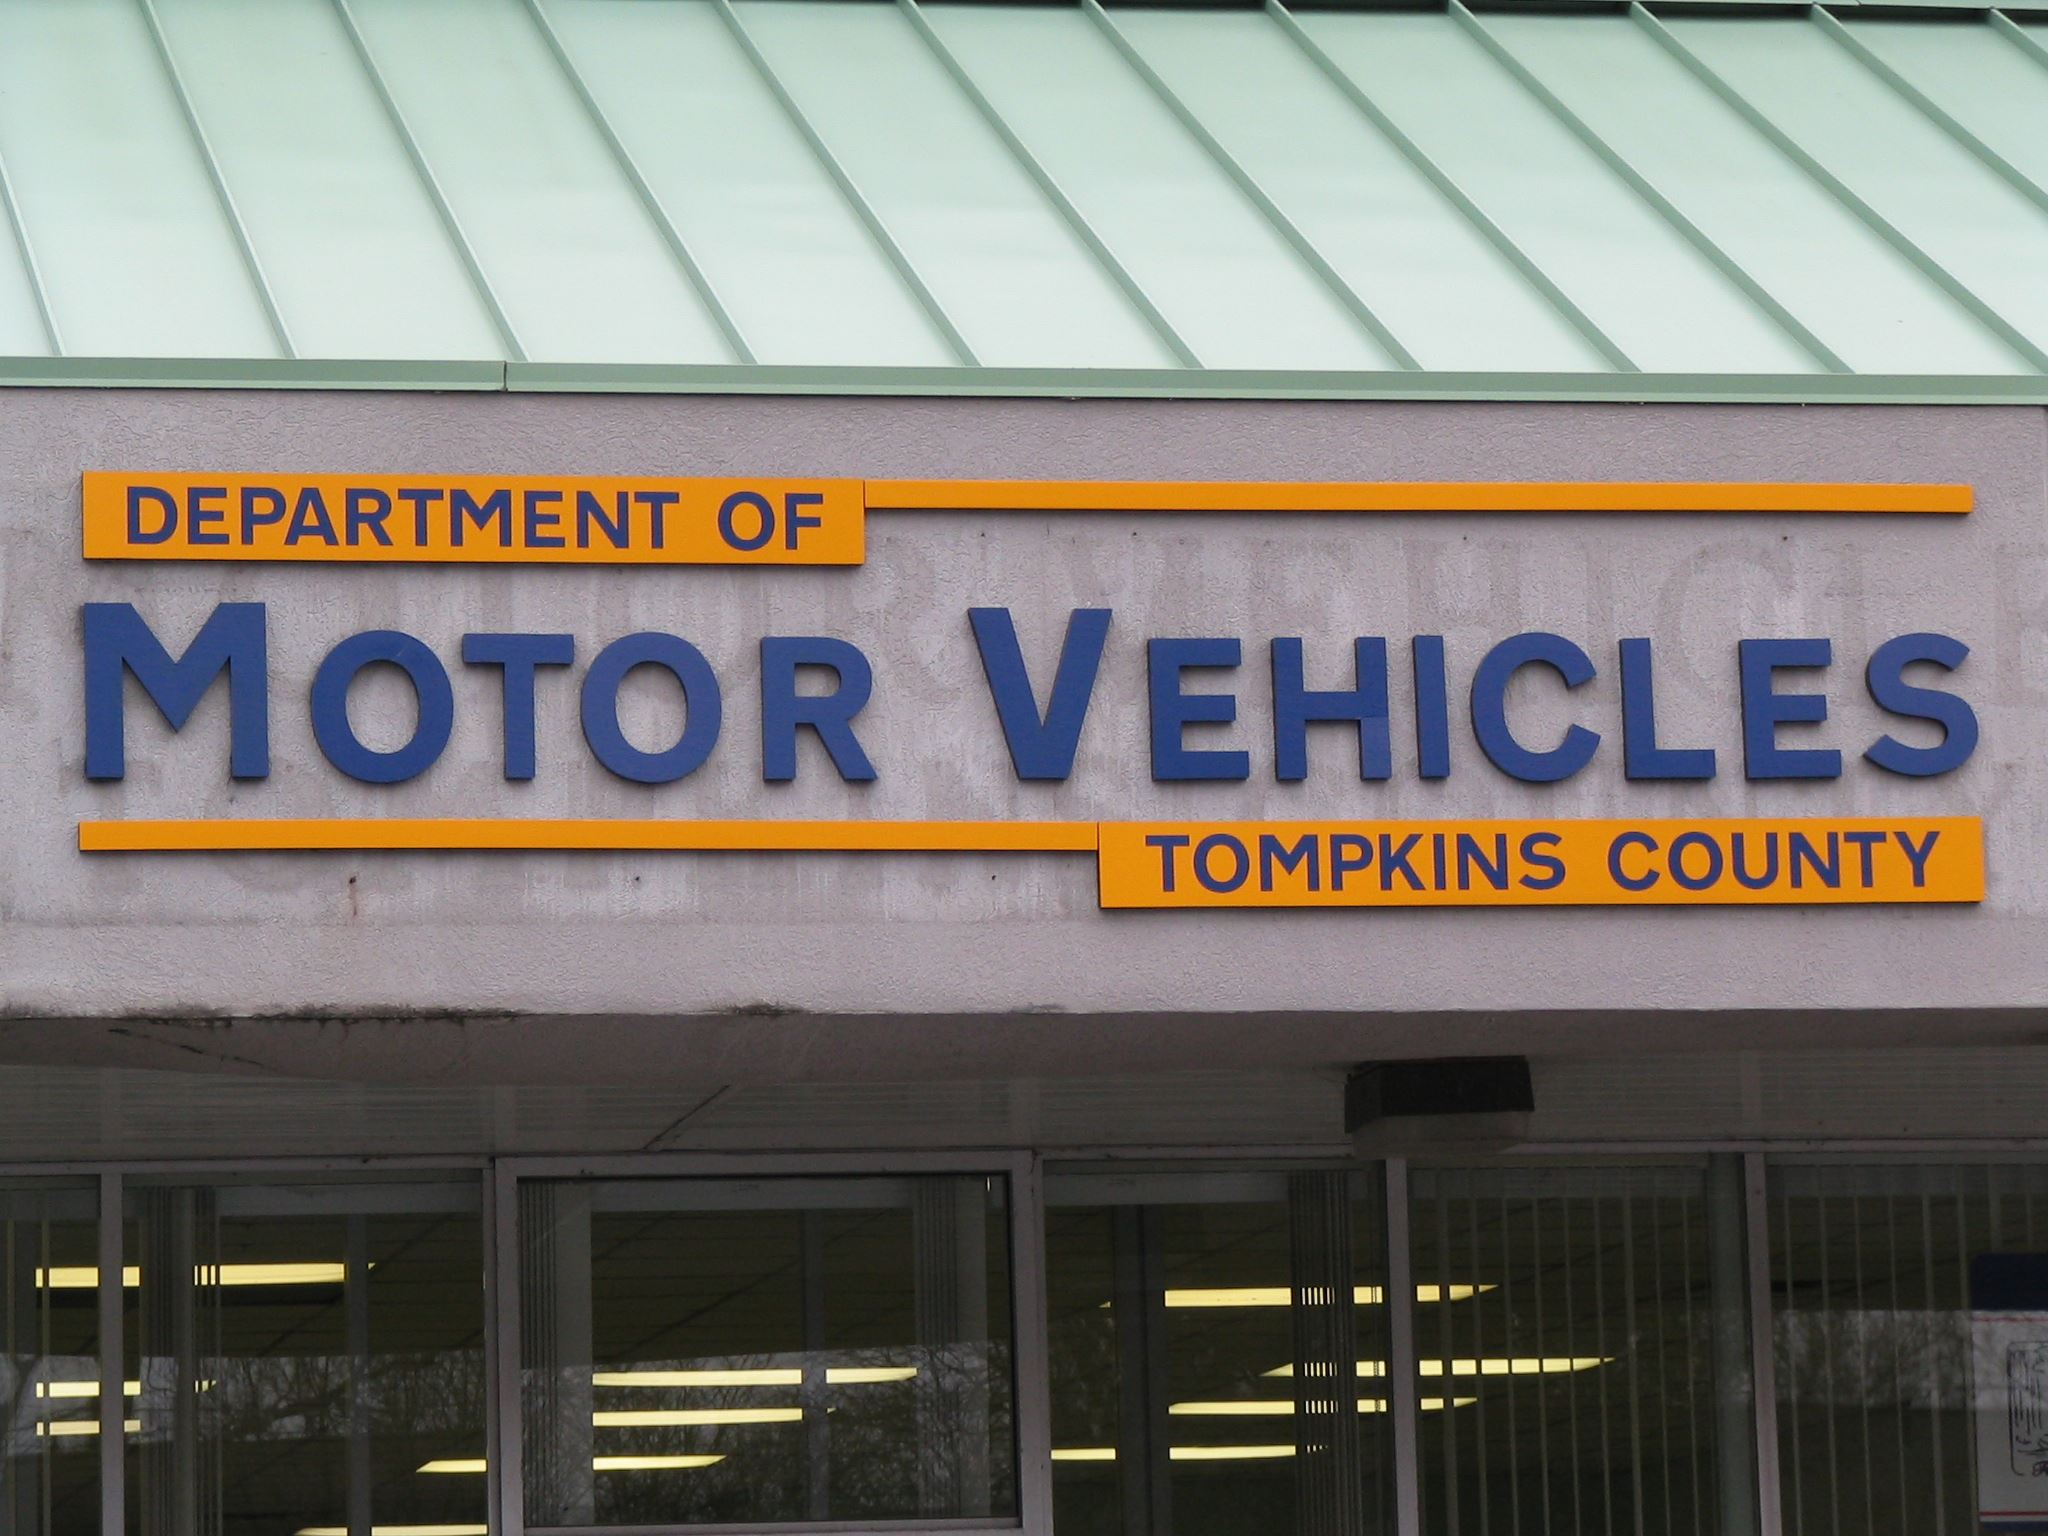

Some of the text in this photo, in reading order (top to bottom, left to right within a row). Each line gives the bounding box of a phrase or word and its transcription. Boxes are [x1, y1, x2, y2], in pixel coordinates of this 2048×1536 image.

[127, 486, 824, 551] DEPARTMENT OF
[83, 601, 1979, 784] MOTOR VEHICLES
[1145, 831, 1941, 893] TOMPKINS COUNTY
